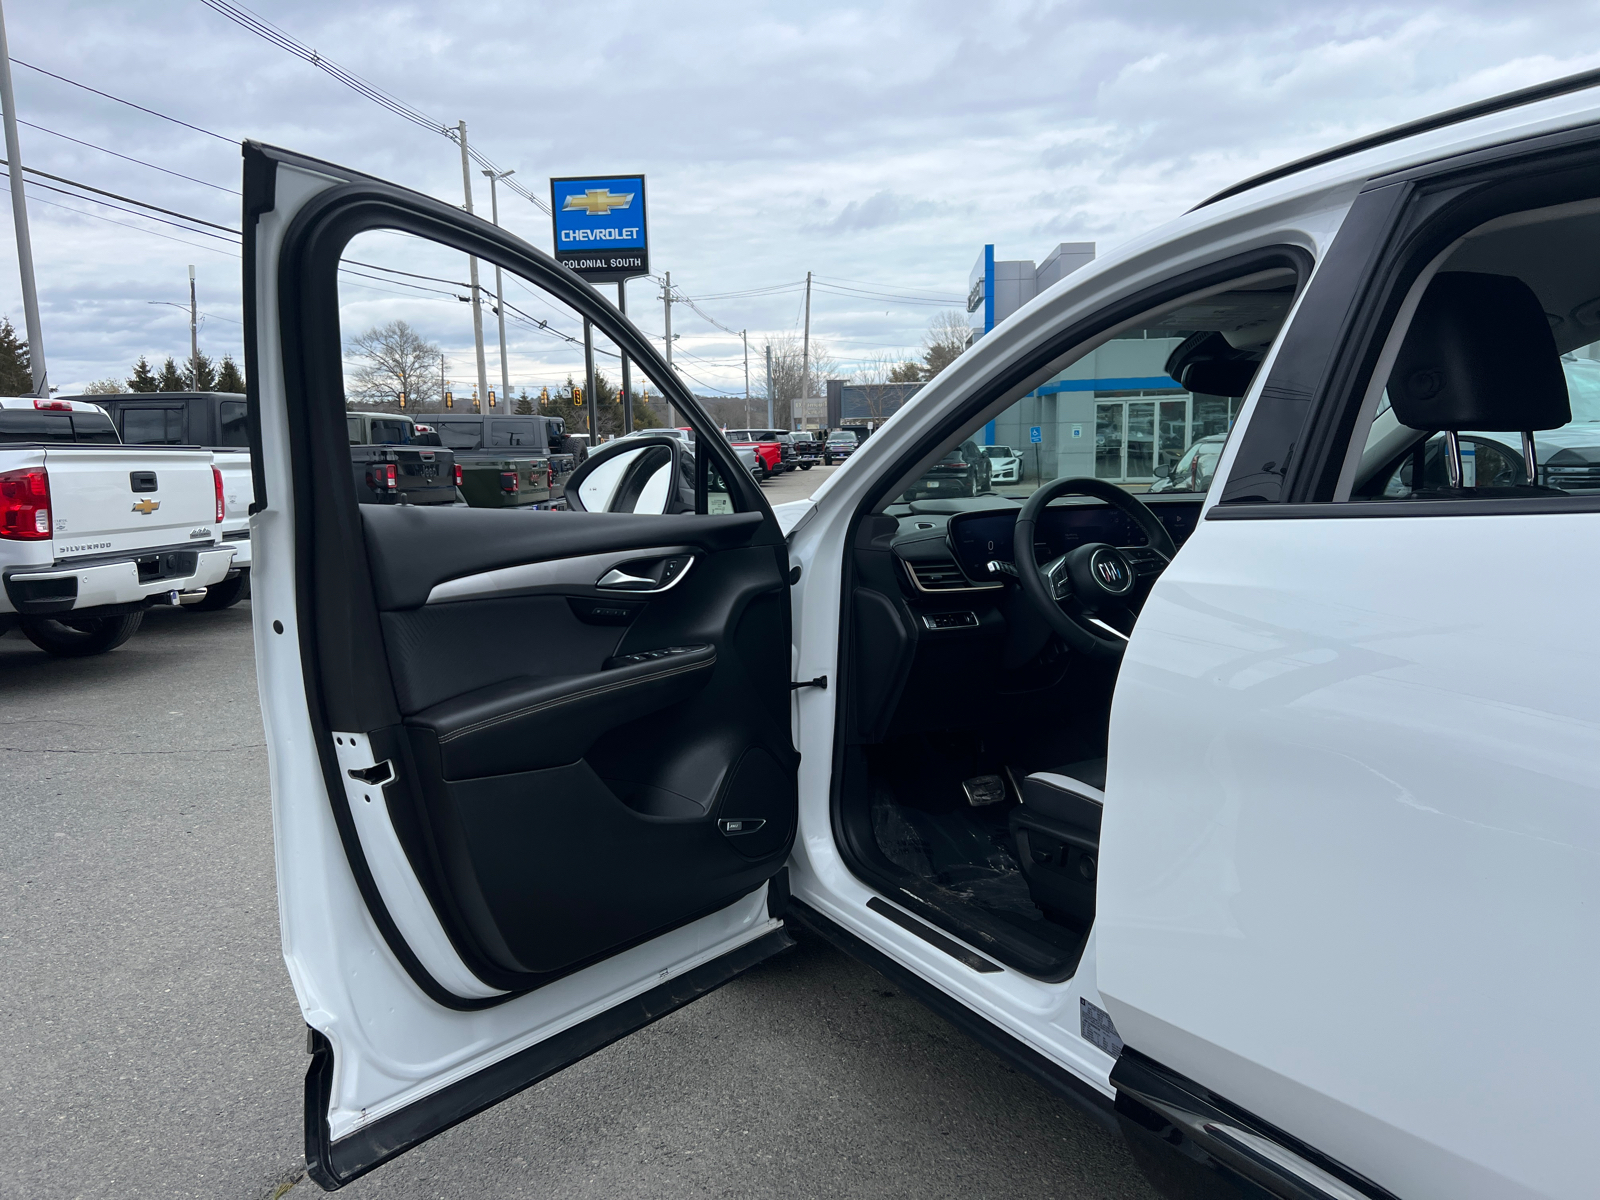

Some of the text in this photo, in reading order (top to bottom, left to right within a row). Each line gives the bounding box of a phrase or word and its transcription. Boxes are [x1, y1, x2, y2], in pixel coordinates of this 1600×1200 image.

[561, 228, 639, 241] CHEVROLET
[562, 258, 641, 269] COLONIAL SOUTH
[59, 542, 112, 554] SILVERADO
